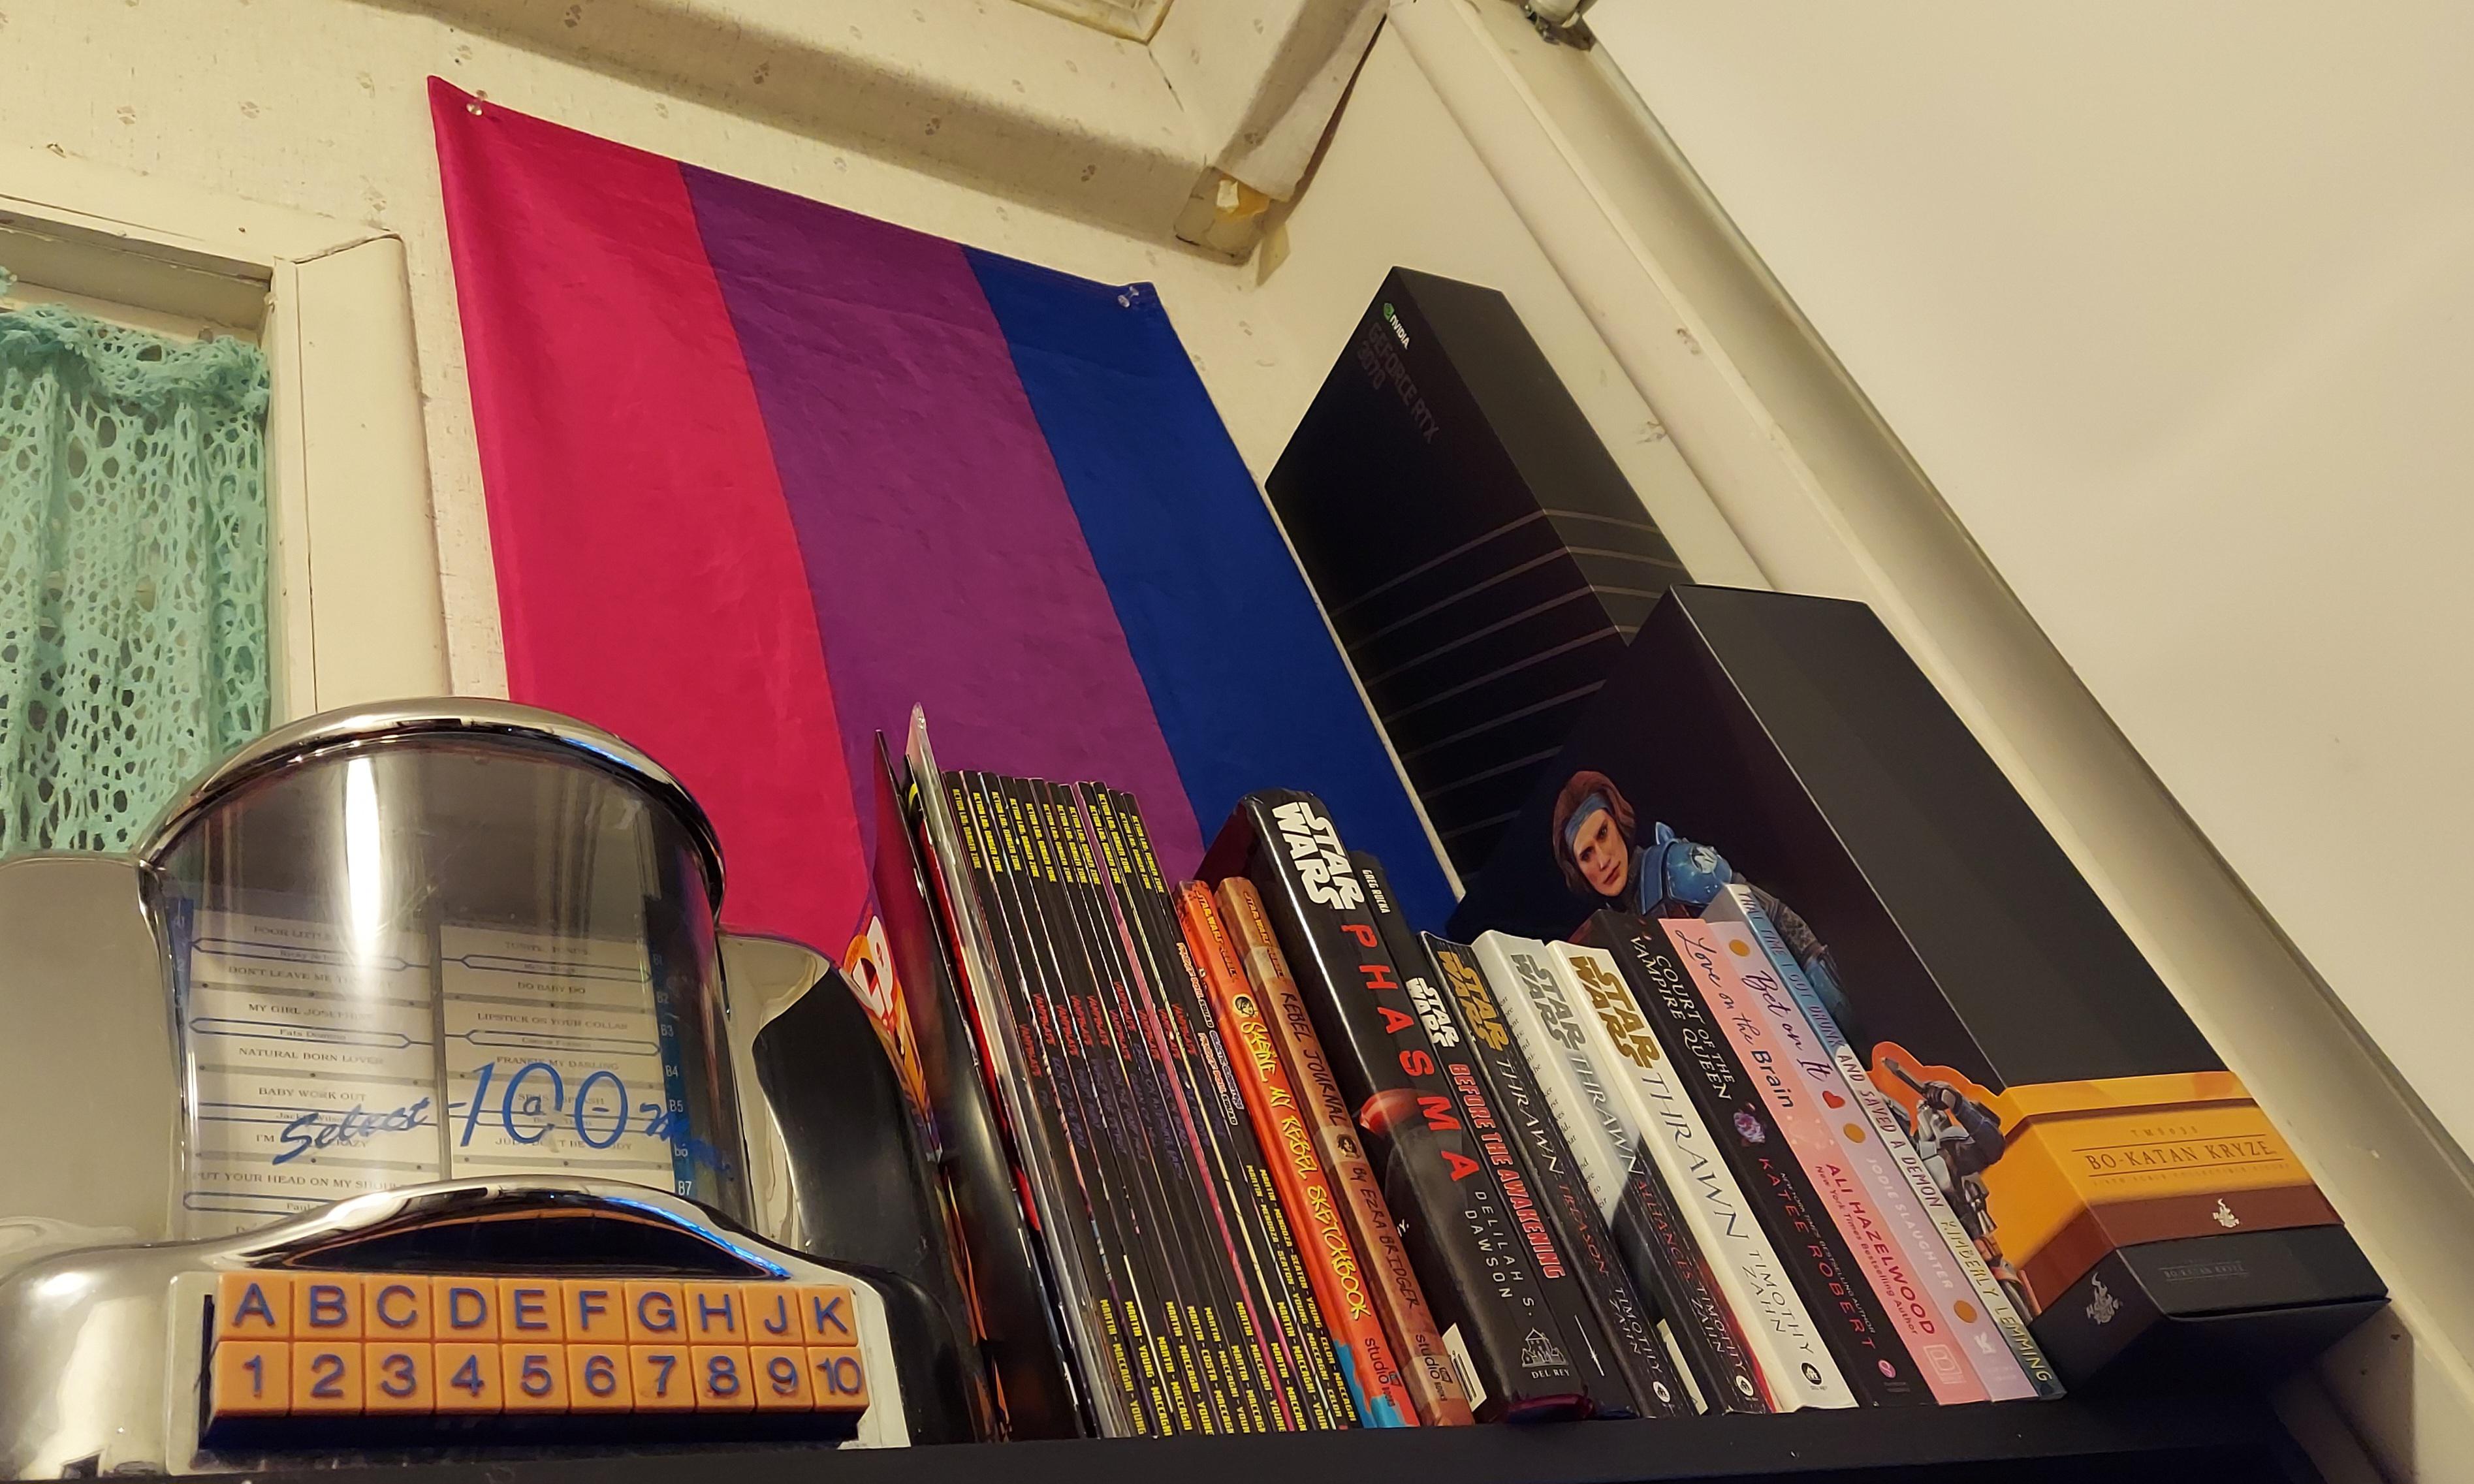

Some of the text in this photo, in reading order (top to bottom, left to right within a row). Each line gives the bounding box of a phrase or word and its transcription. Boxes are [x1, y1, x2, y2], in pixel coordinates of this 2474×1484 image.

[1389, 314, 1410, 349] NVIDIA
[1369, 323, 1439, 444] GEFORCE RTX
[973, 793, 985, 814] ACTION
[985, 830, 997, 855] DANGER
[992, 856, 1003, 872] ZONE
[1272, 802, 1343, 909] WARS
[1299, 802, 1364, 909] STAR
[1194, 891, 1224, 943] STAR WARS
[1245, 892, 1271, 944] STAR WARS
[1363, 870, 1390, 913] GREG RUCKA
[249, 1003, 267, 1013] MY
[271, 1005, 300, 1015] GIRL
[477, 1013, 529, 1024] LIPSTICK
[661, 1024, 674, 1037] B3
[1406, 978, 1448, 1052] WARS
[1418, 978, 1459, 1047] STAR
[1438, 951, 1498, 1049] WARS
[1451, 952, 1508, 1050] STAR
[1510, 955, 1571, 1049] WARS
[1526, 955, 1585, 1050] STAR
[1569, 956, 1643, 1067] WARS
[1587, 956, 1660, 1068] STAR
[1630, 935, 1732, 1099] VAMPIRE QUEEN
[1657, 956, 1735, 1082] COURT OF THE
[1675, 930, 1793, 1107] Love on the Brain
[1741, 971, 1833, 1081] Bet on It
[239, 1047, 298, 1060] NATURAL
[303, 1052, 338, 1062] BORN
[259, 1087, 366, 1101] BABY WORK OUT
[665, 1066, 678, 1077] B4
[1281, 993, 1347, 1129] REBEL JOURNAL
[1341, 924, 1479, 1181] PHASMA
[1737, 889, 1763, 919] THAT
[1761, 930, 1784, 955] TIME
[1789, 975, 1813, 997] GOT
[1809, 1007, 1844, 1051] DRUNK
[1837, 1056, 1865, 1081] AND
[1860, 1091, 1896, 1131] SAVED
[1901, 1158, 1944, 1207] DEMON
[272, 1097, 430, 1165] Select
[670, 1100, 684, 1113] B5
[1497, 1059, 1564, 1174] THRAWN
[1572, 1056, 1643, 1176] THRAWN
[225, 1173, 262, 1182] YOUR
[268, 1175, 306, 1186] HEAD
[311, 1178, 327, 1187] ON
[333, 1179, 351, 1188] MY
[678, 1182, 691, 1195] B7
[1241, 1016, 1371, 1321] SABINE MY REBEL SKETCHBOOK
[1448, 1064, 1496, 1128] BEFORE
[1481, 1132, 1513, 1172] THE
[1497, 1162, 1566, 1278] AWAKENING
[1641, 1073, 1750, 1239] THRAWN
[2085, 1141, 2272, 1170] BO-KATAN KRYZE
[1260, 1169, 1276, 1201] MARTIN
[1307, 1297, 1322, 1328] YOUNG
[1361, 1189, 1387, 1228] EZRA
[1380, 1236, 1419, 1309] BRIDGER
[1465, 1210, 1512, 1297] DAWSON
[1475, 1192, 1534, 1316] DELILAH S.
[1559, 1186, 1608, 1274] TREASON
[1636, 1180, 1692, 1282] ALLIANCES
[1759, 1159, 1875, 1349] KATEE ROBERT
[1815, 1167, 1918, 1334] New York Times Bestselling Author
[1826, 1165, 1935, 1334] ALI HAZELWOOD
[1866, 1159, 1953, 1287] JODIE SLAUGHTER
[232, 1284, 849, 1334] A B C D E F G H J K
[1610, 1299, 1641, 1354] ZAHN
[1615, 1287, 1662, 1372] TIMOTHY
[1691, 1298, 1724, 1352] ZAHN
[1697, 1286, 1746, 1371] TIMOTHY
[1743, 1267, 1786, 1332] ZAHN
[1749, 1250, 1814, 1353] TIMOTHY
[1941, 1222, 2055, 1381] KIMBERLY LEMMING
[244, 1355, 862, 1397] 1 2 3 4 5 6 7 8 9 10
[1365, 1338, 1395, 1384] studio
[1416, 1334, 1443, 1379] studio
[1532, 1367, 1570, 1379] DEL REY
